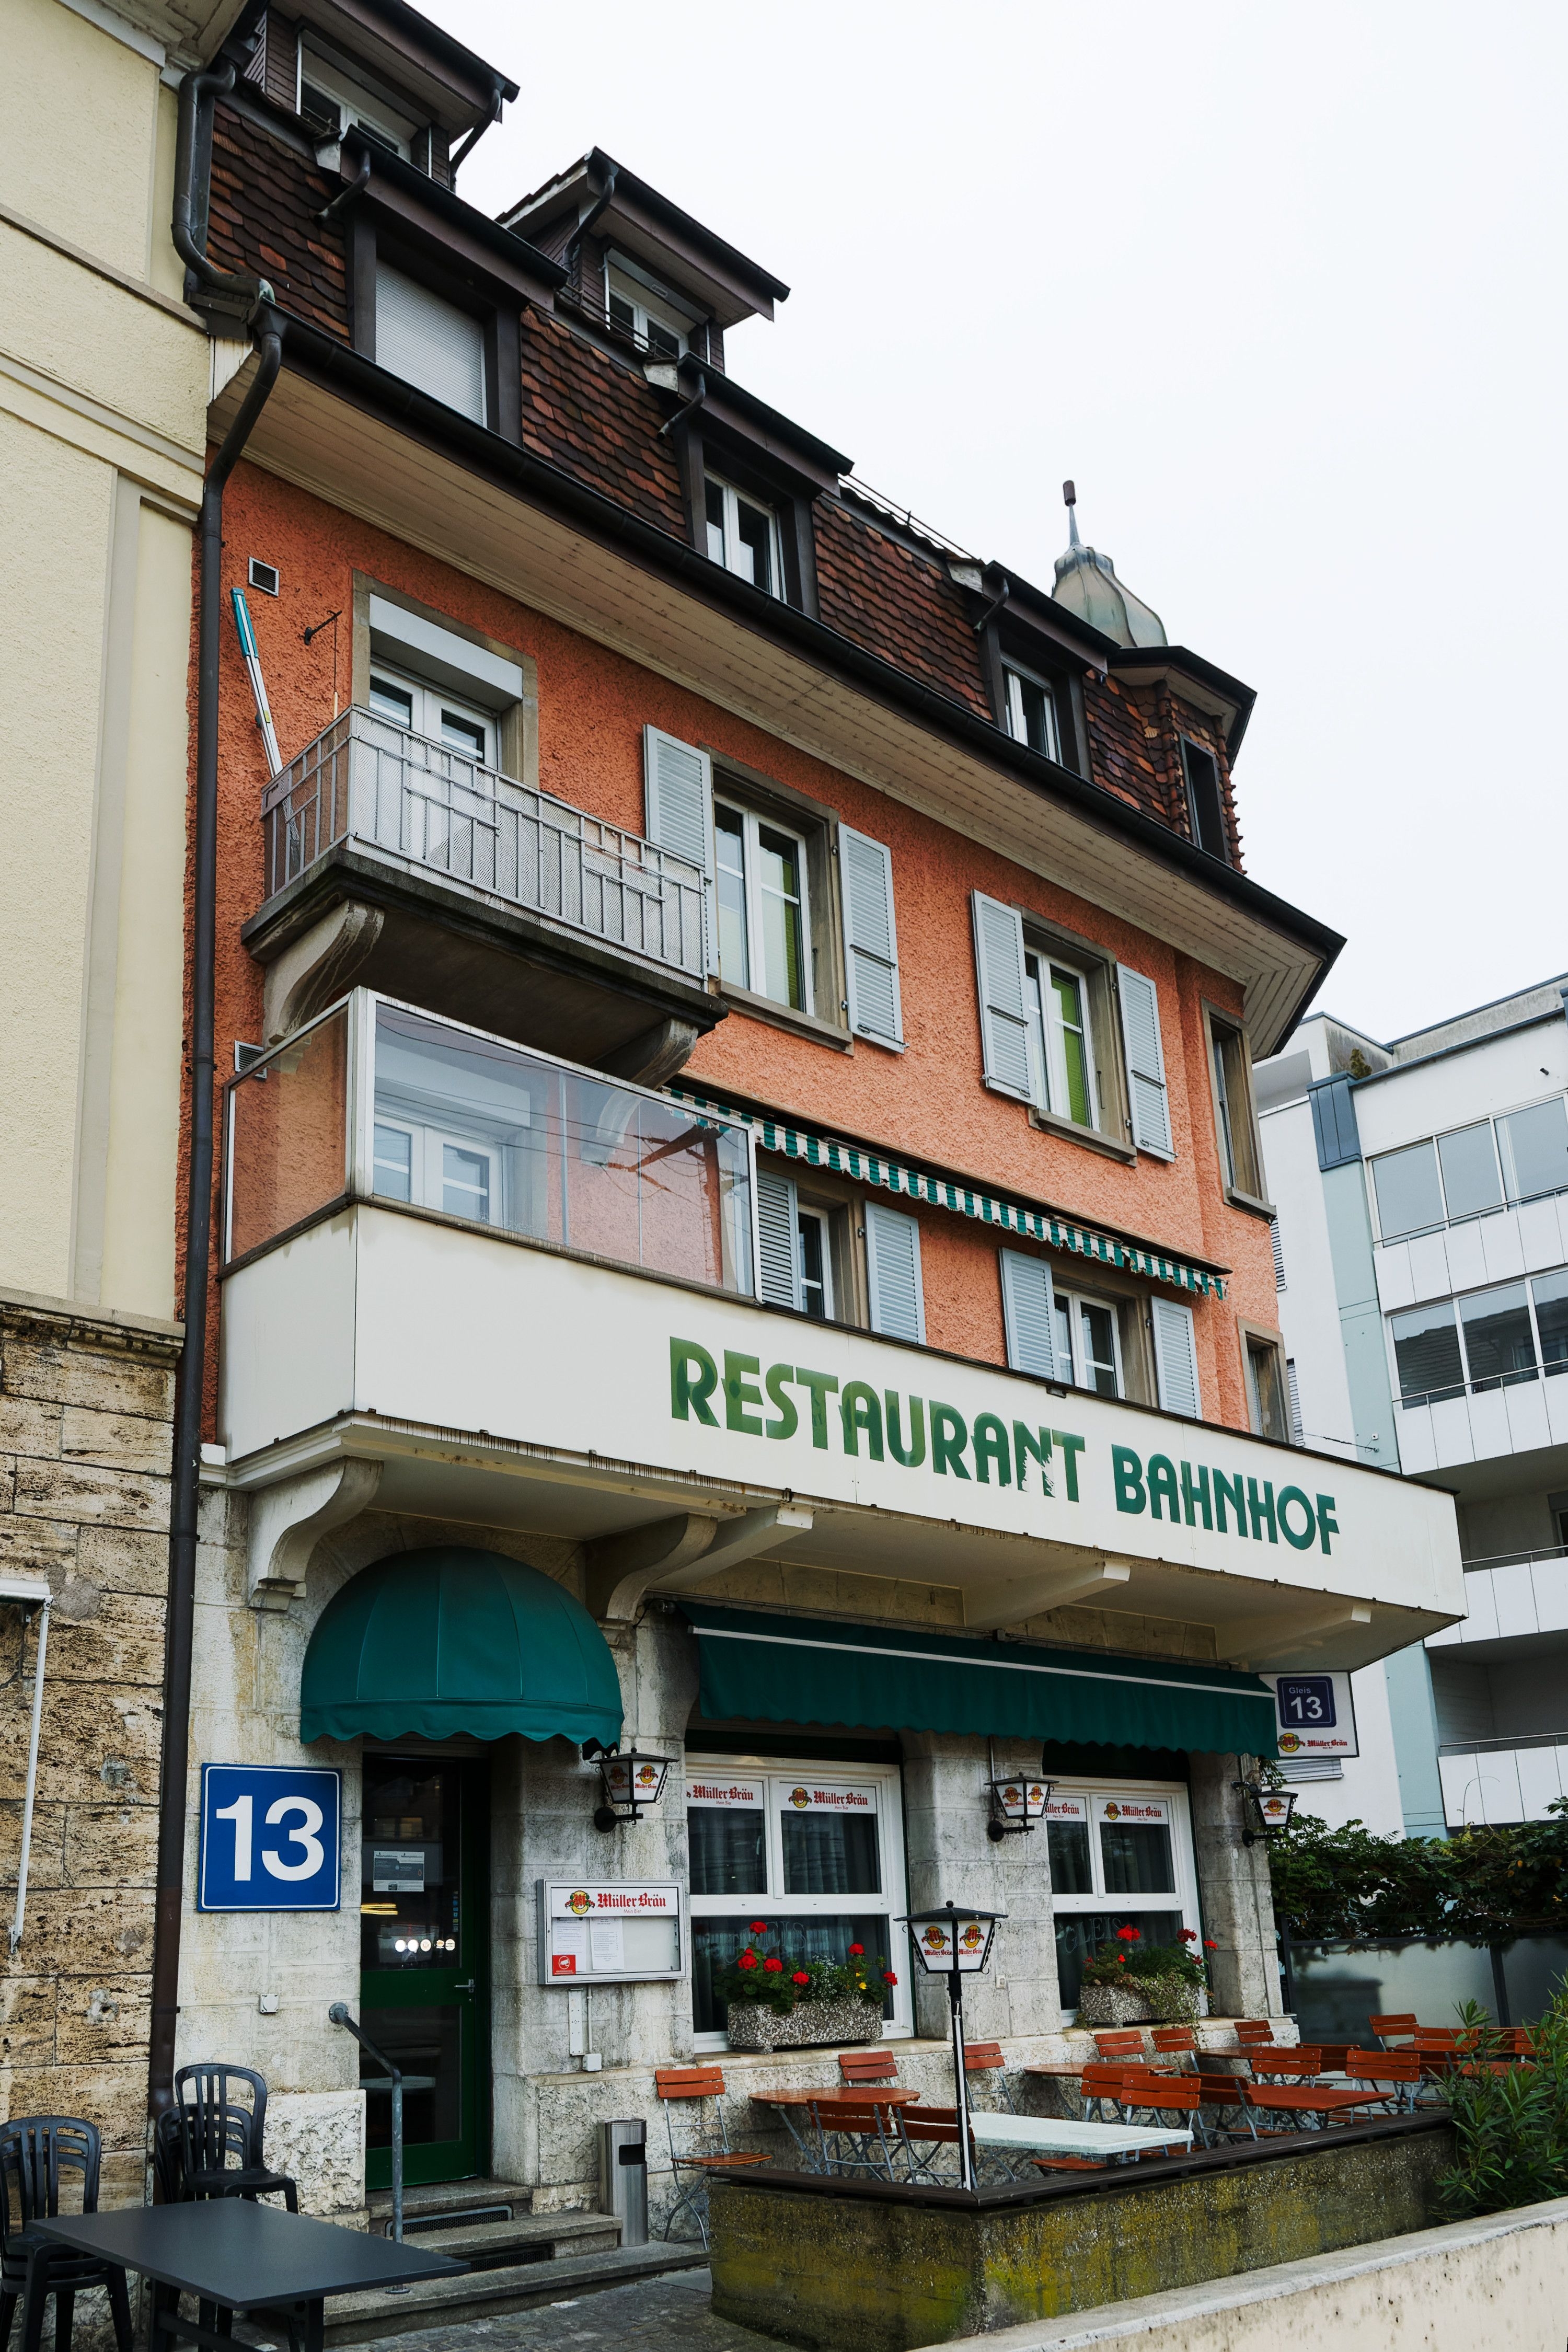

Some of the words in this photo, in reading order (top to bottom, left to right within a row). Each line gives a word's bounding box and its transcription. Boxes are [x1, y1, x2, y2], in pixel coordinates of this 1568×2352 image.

[670, 1336, 1086, 1503] RESTAURANT
[1112, 1443, 1340, 1554] BAHNHOF
[1291, 1697, 1322, 1719] 13
[693, 1785, 728, 1800] Müller
[729, 1786, 754, 1801] Bräu
[814, 1791, 845, 1805] Müller
[846, 1792, 868, 1805] Bräu
[1061, 1803, 1079, 1814] Bräu
[1122, 1805, 1145, 1816] Müller
[1145, 1806, 1162, 1817] Bräu
[216, 1795, 324, 1881] 13
[597, 1893, 637, 1908] Müller
[638, 1892, 666, 1907] Bräu
